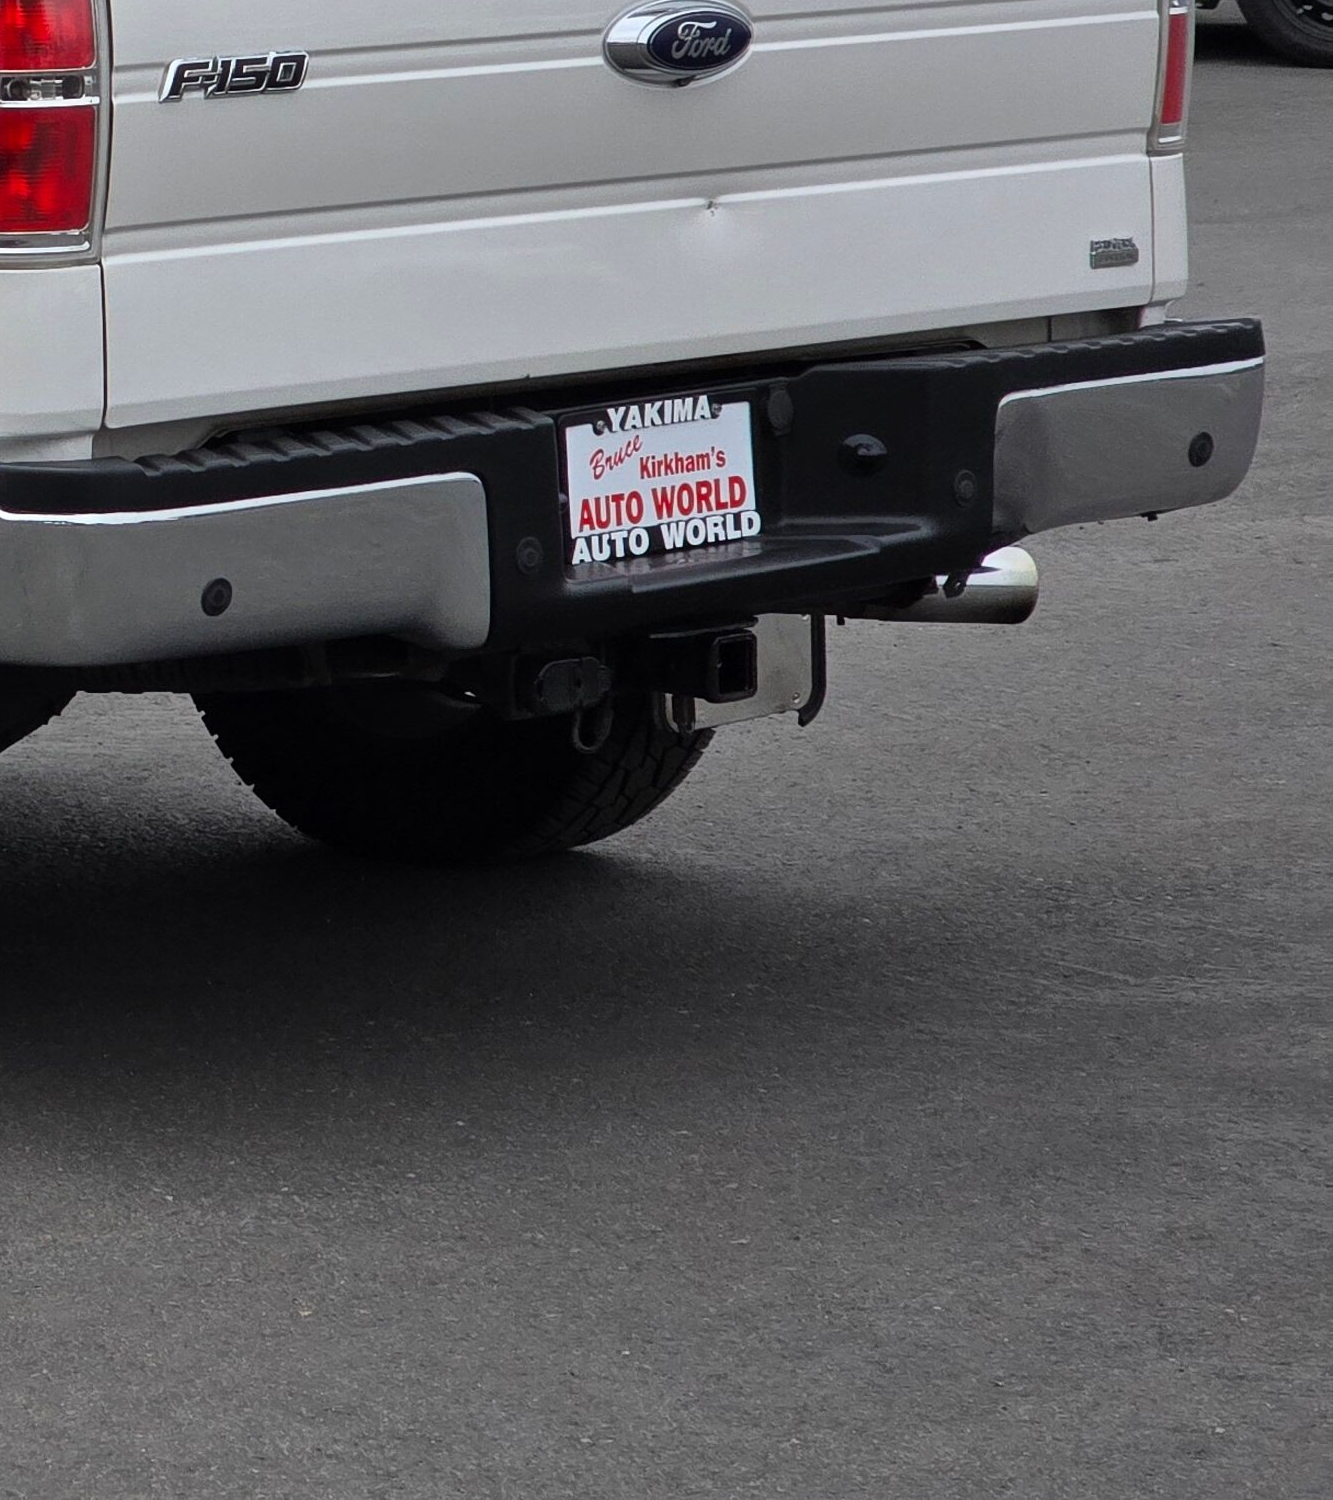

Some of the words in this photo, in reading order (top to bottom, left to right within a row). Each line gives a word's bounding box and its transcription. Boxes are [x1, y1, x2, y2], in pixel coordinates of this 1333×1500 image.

[670, 20, 733, 60] Ford
[158, 50, 310, 103] F-150
[607, 396, 711, 432] YAKIMA
[589, 435, 643, 480] Bruce
[639, 446, 726, 480] Kirkham's
[579, 490, 645, 533] AUTO
[651, 475, 747, 521] WORLD
[572, 528, 650, 565] AUTO
[660, 510, 761, 550] WORLD
